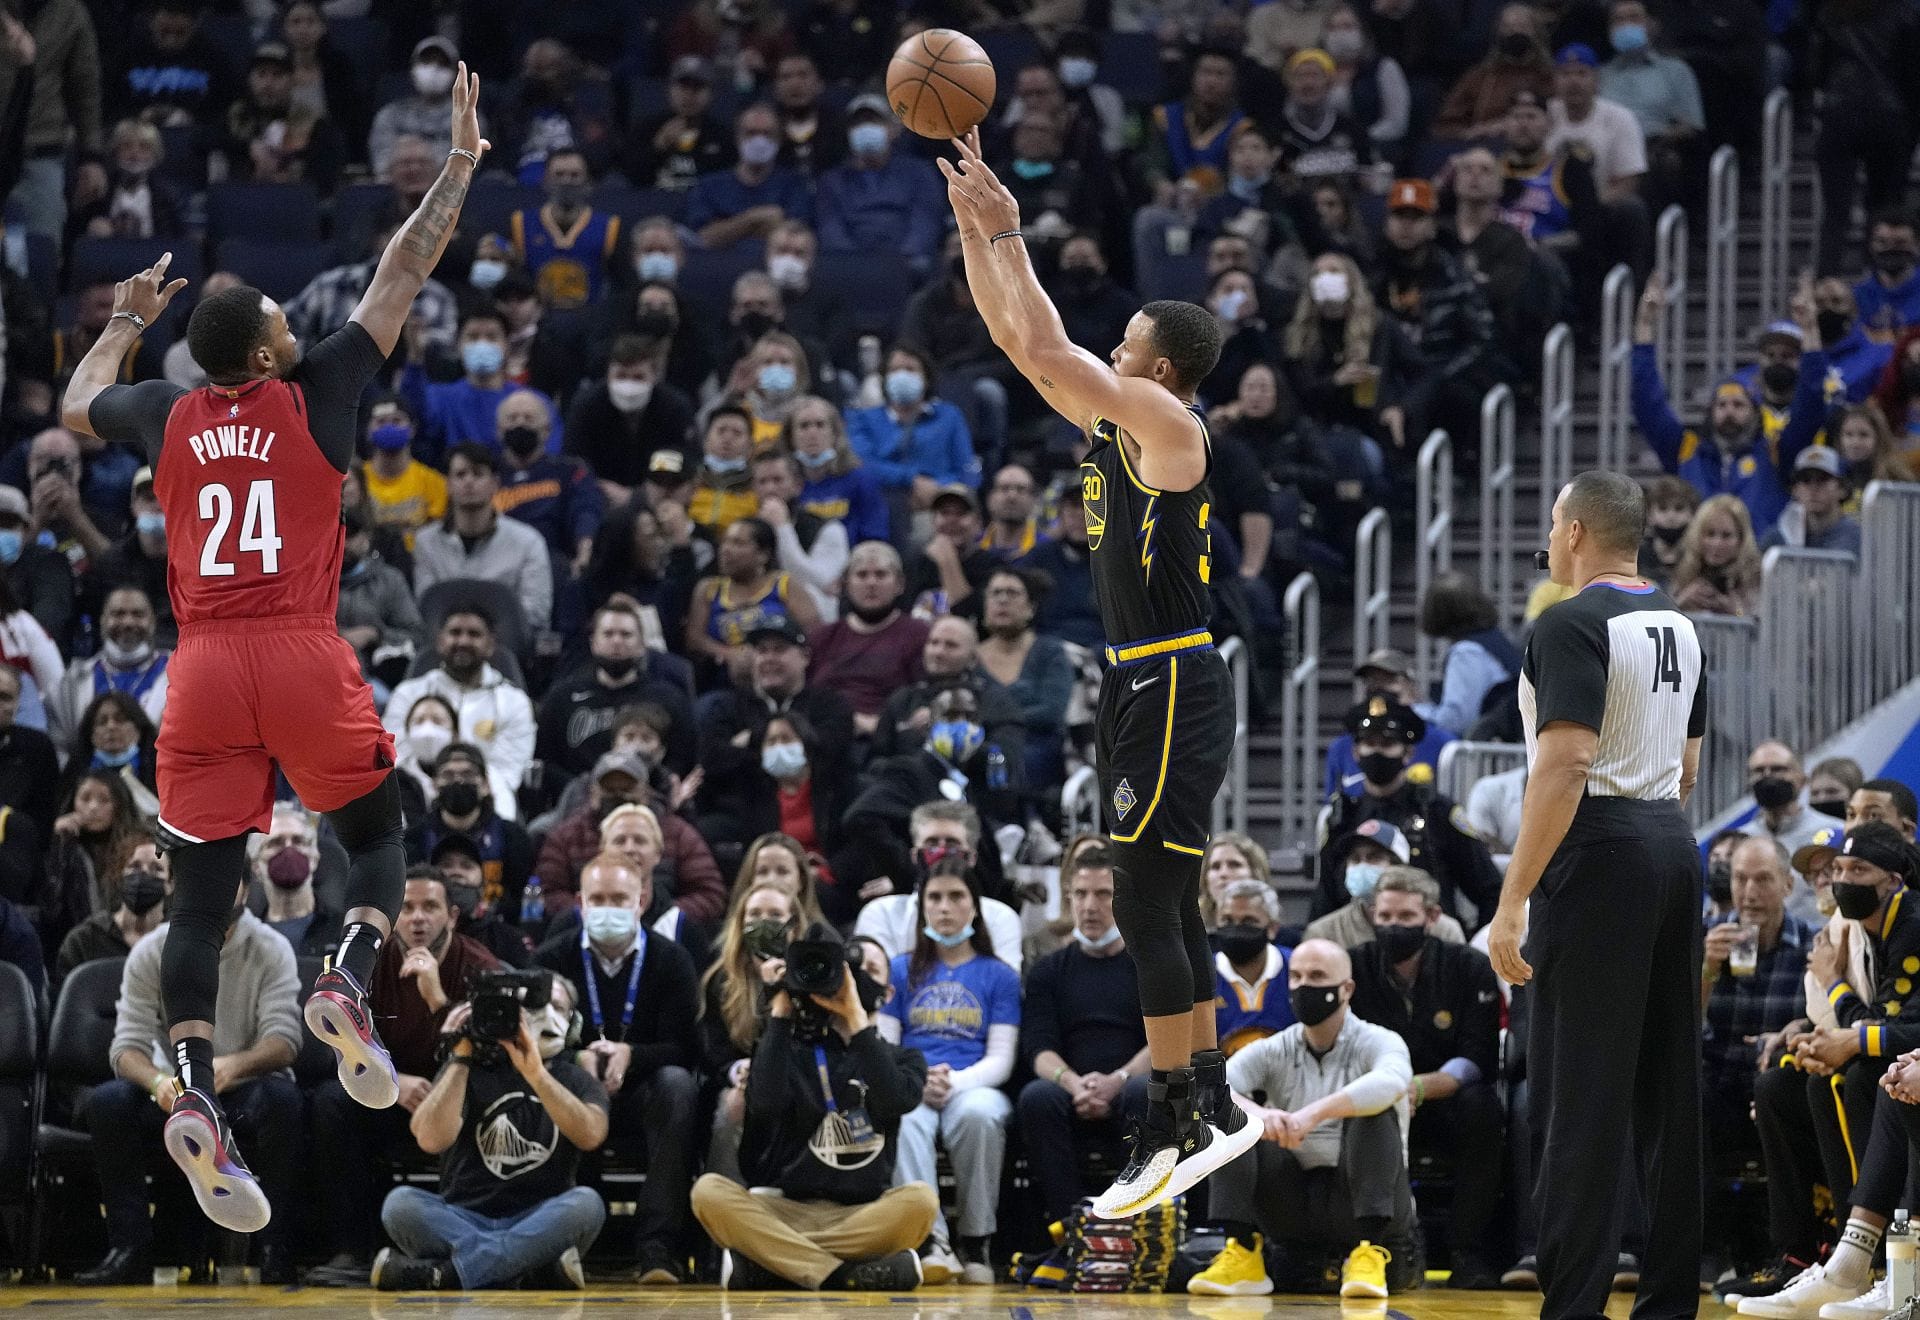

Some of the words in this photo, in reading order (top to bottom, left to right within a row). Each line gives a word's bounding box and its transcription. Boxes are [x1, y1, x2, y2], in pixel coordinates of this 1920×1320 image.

[188, 424, 276, 466] POWELL
[1083, 476, 1101, 500] 30
[198, 479, 283, 576] 24
[1645, 627, 1682, 693] 14
